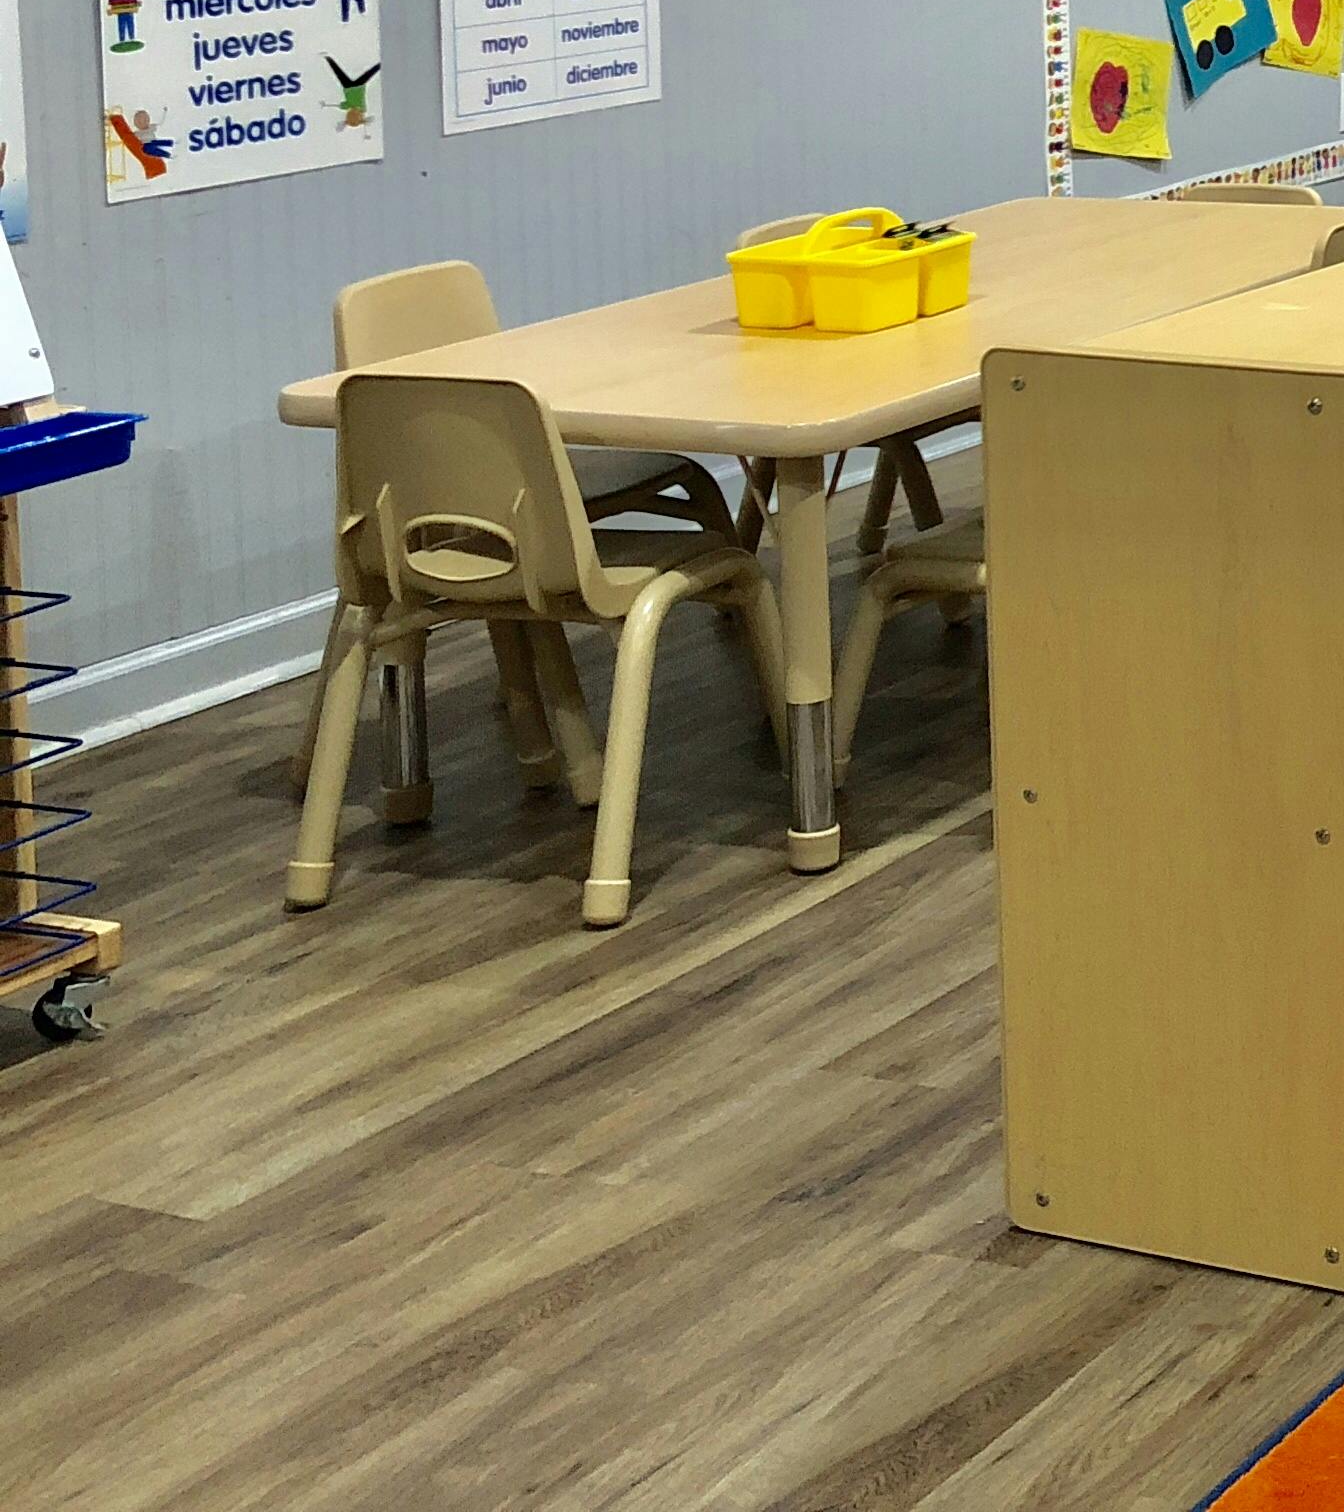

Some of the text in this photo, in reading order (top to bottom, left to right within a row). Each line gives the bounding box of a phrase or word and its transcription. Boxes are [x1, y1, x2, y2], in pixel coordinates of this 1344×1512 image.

[561, 17, 640, 43] noviembre
[193, 29, 294, 71] jueves
[481, 35, 529, 55] mayo
[566, 59, 638, 85] diciembre
[188, 71, 301, 107] viernes
[484, 76, 528, 103] junio
[188, 110, 306, 152] sábado
